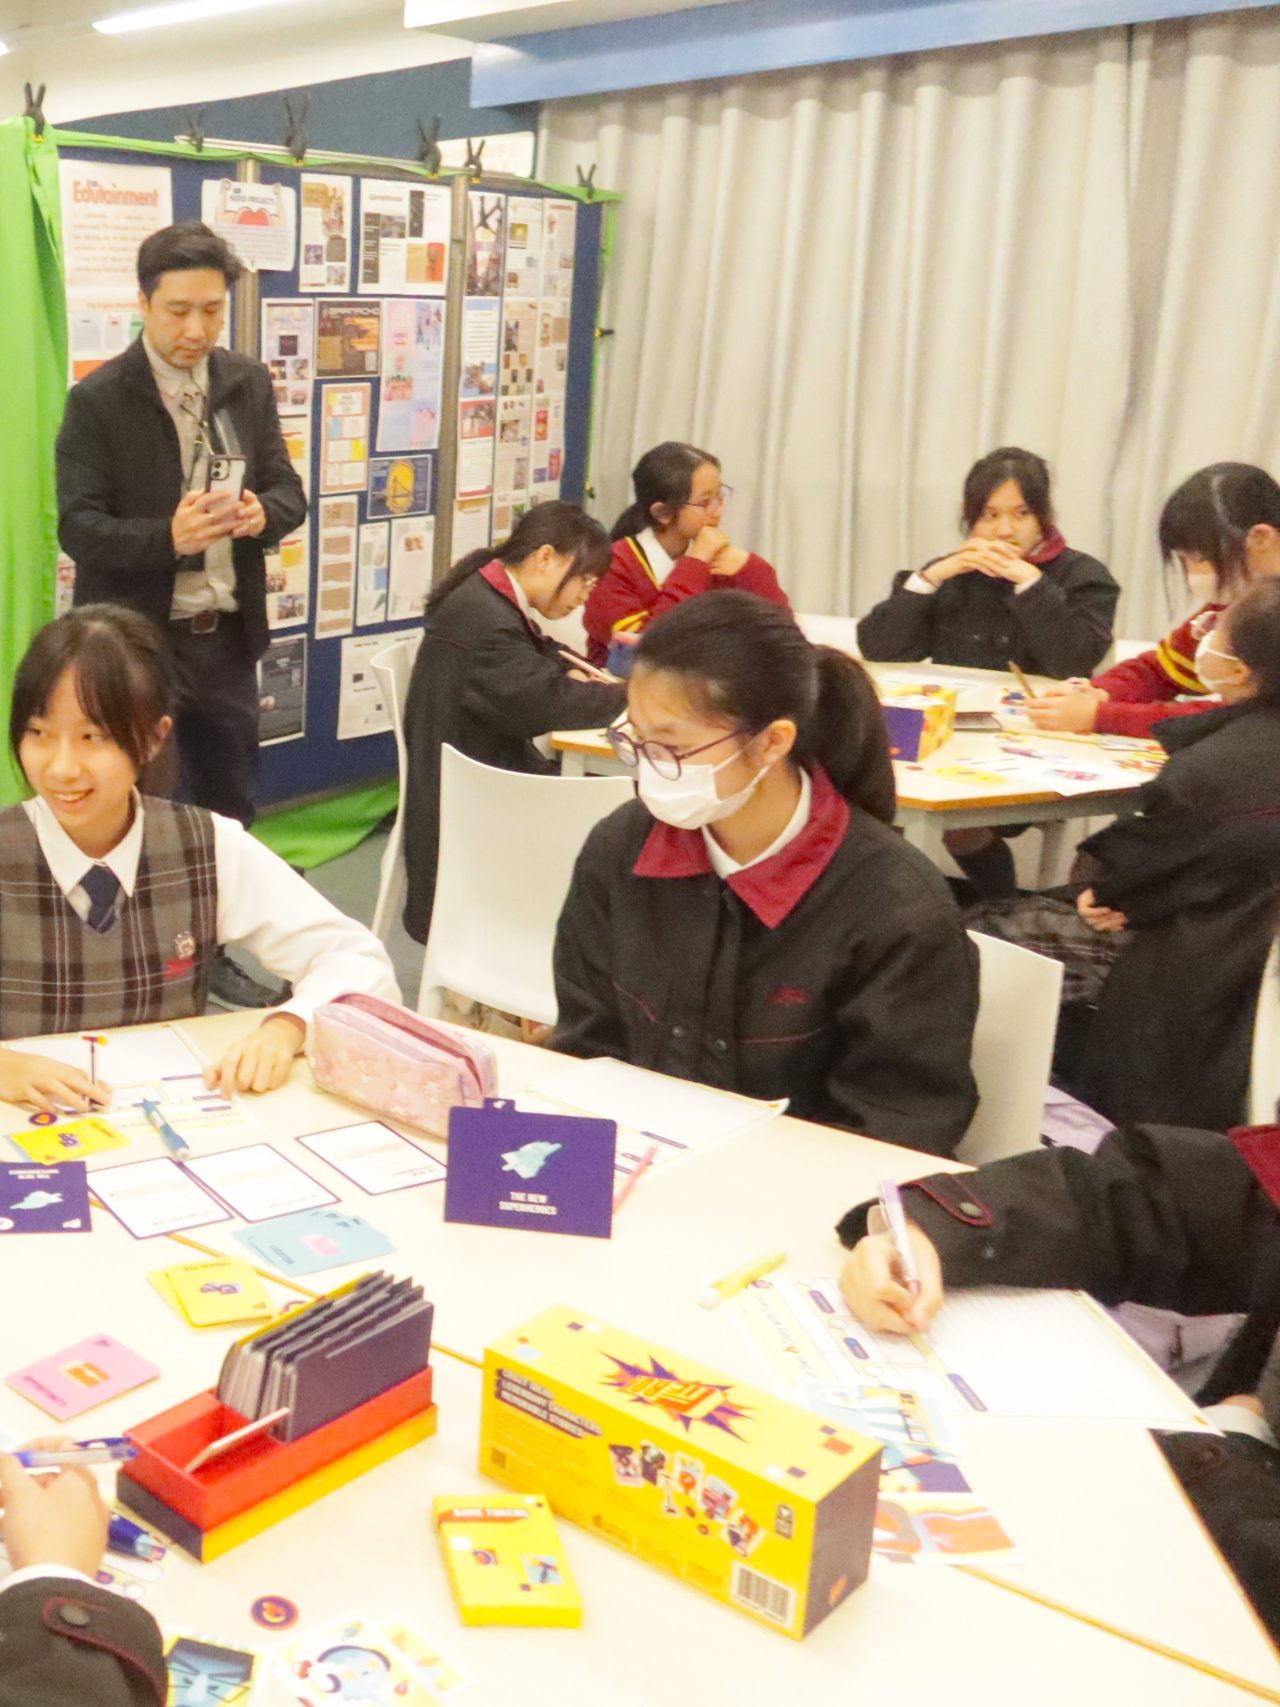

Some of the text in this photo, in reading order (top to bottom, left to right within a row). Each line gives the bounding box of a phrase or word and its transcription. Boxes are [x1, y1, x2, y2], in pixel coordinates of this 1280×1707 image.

[73, 180, 158, 207] Edutainment
[510, 1191, 548, 1204] THE NEW
[499, 1200, 557, 1216] SUPERHEROES
